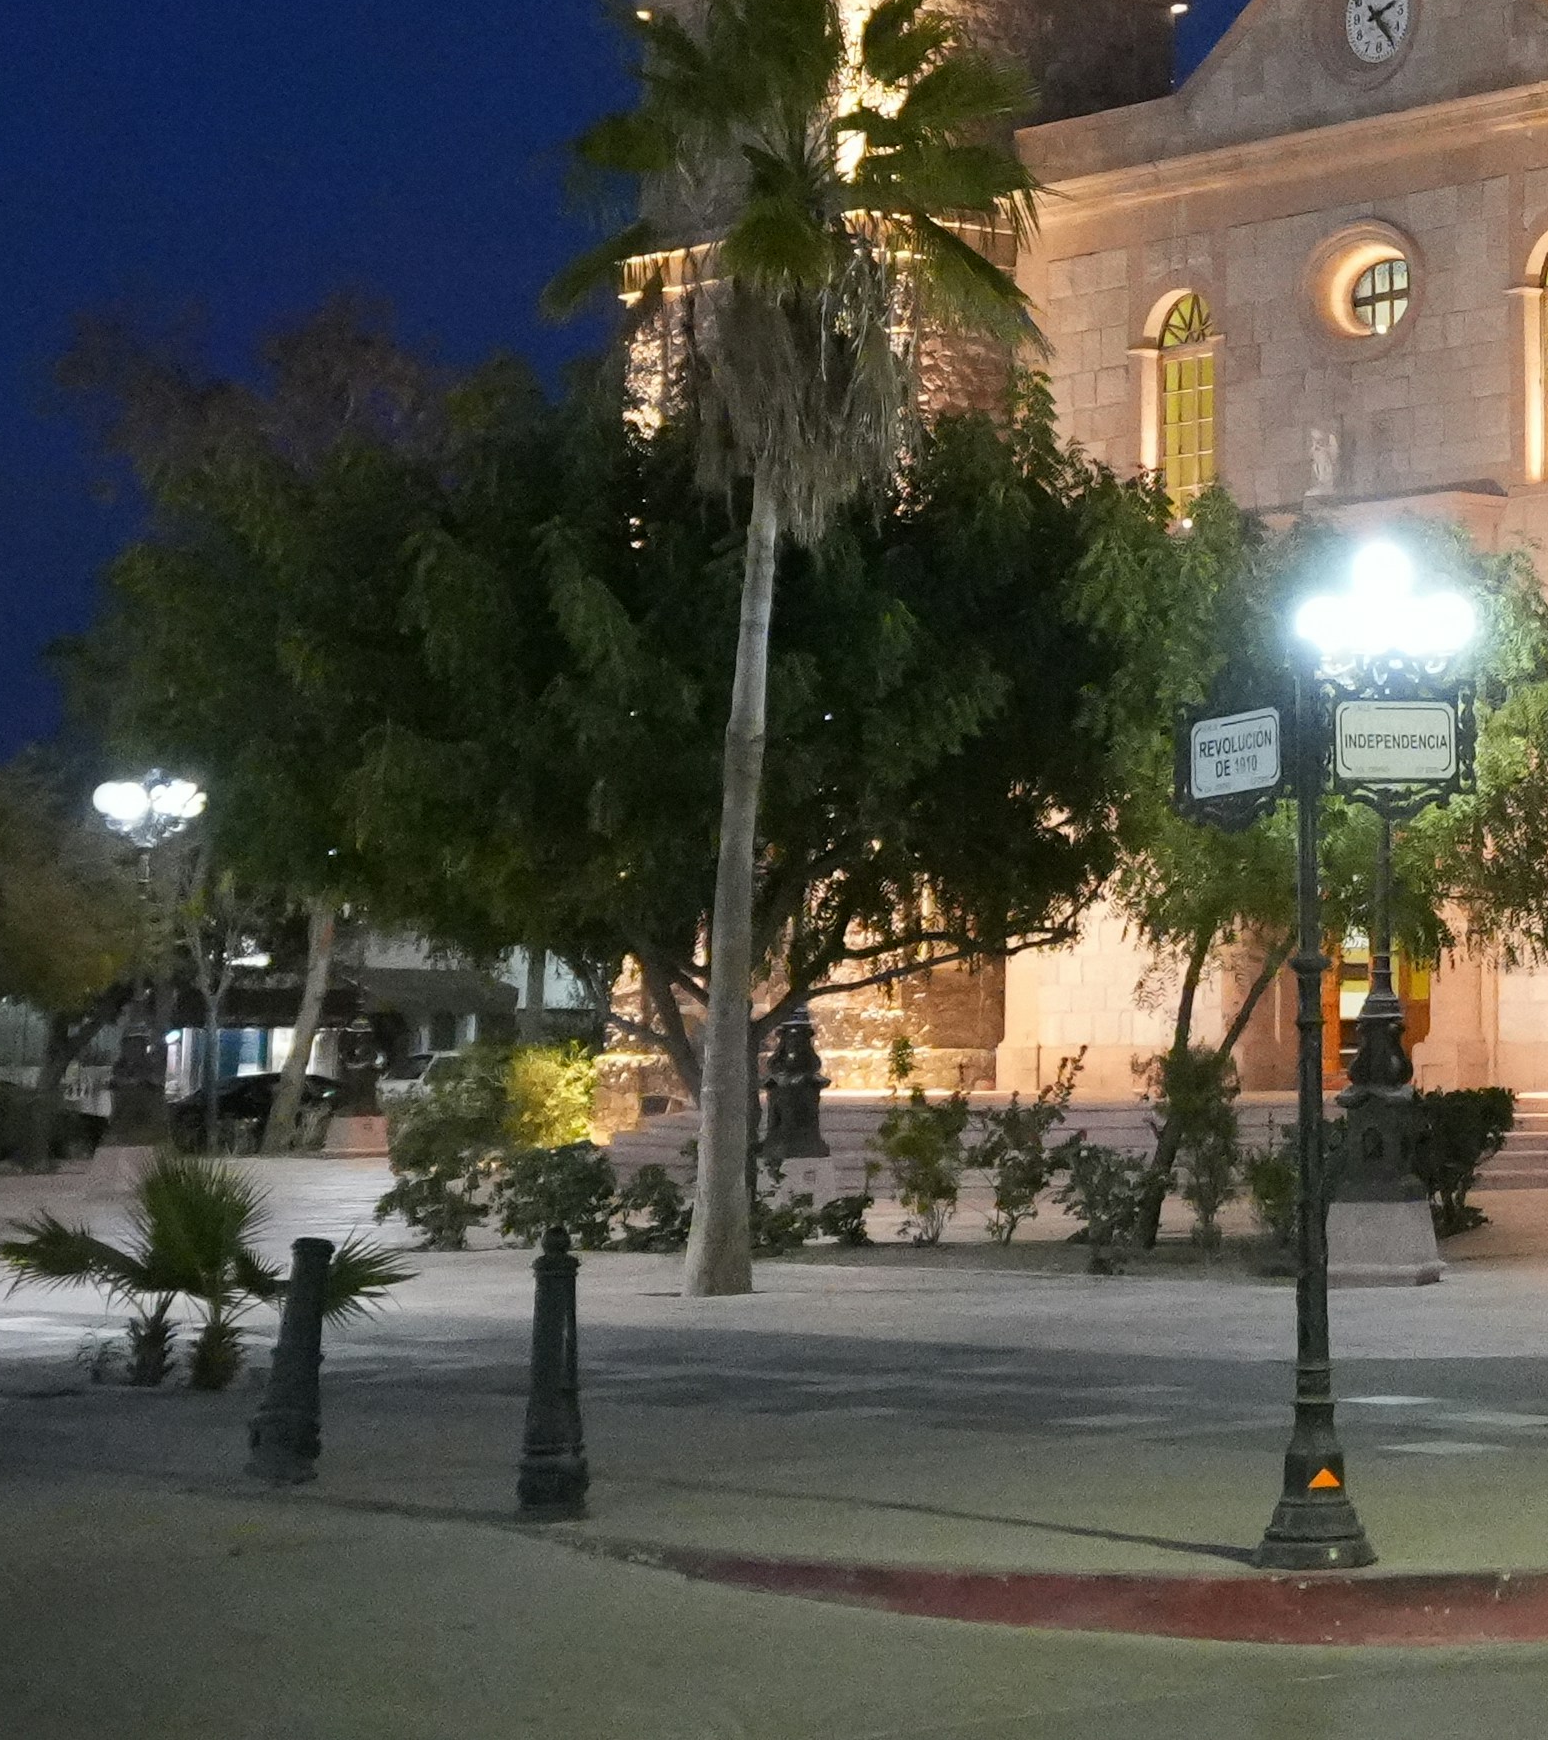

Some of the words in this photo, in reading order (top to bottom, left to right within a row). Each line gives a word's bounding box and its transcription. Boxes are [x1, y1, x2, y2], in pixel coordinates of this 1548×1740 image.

[1397, 4, 1404, 15] 3
[1353, 14, 1361, 25] 9
[1356, 30, 1363, 41] 8
[1364, 40, 1371, 53] 7
[1199, 726, 1272, 758] REVOLUCIÓN
[1344, 733, 1448, 750] INDEPENDENCIA
[1215, 759, 1231, 778] DE
[1233, 755, 1258, 774] 1910
